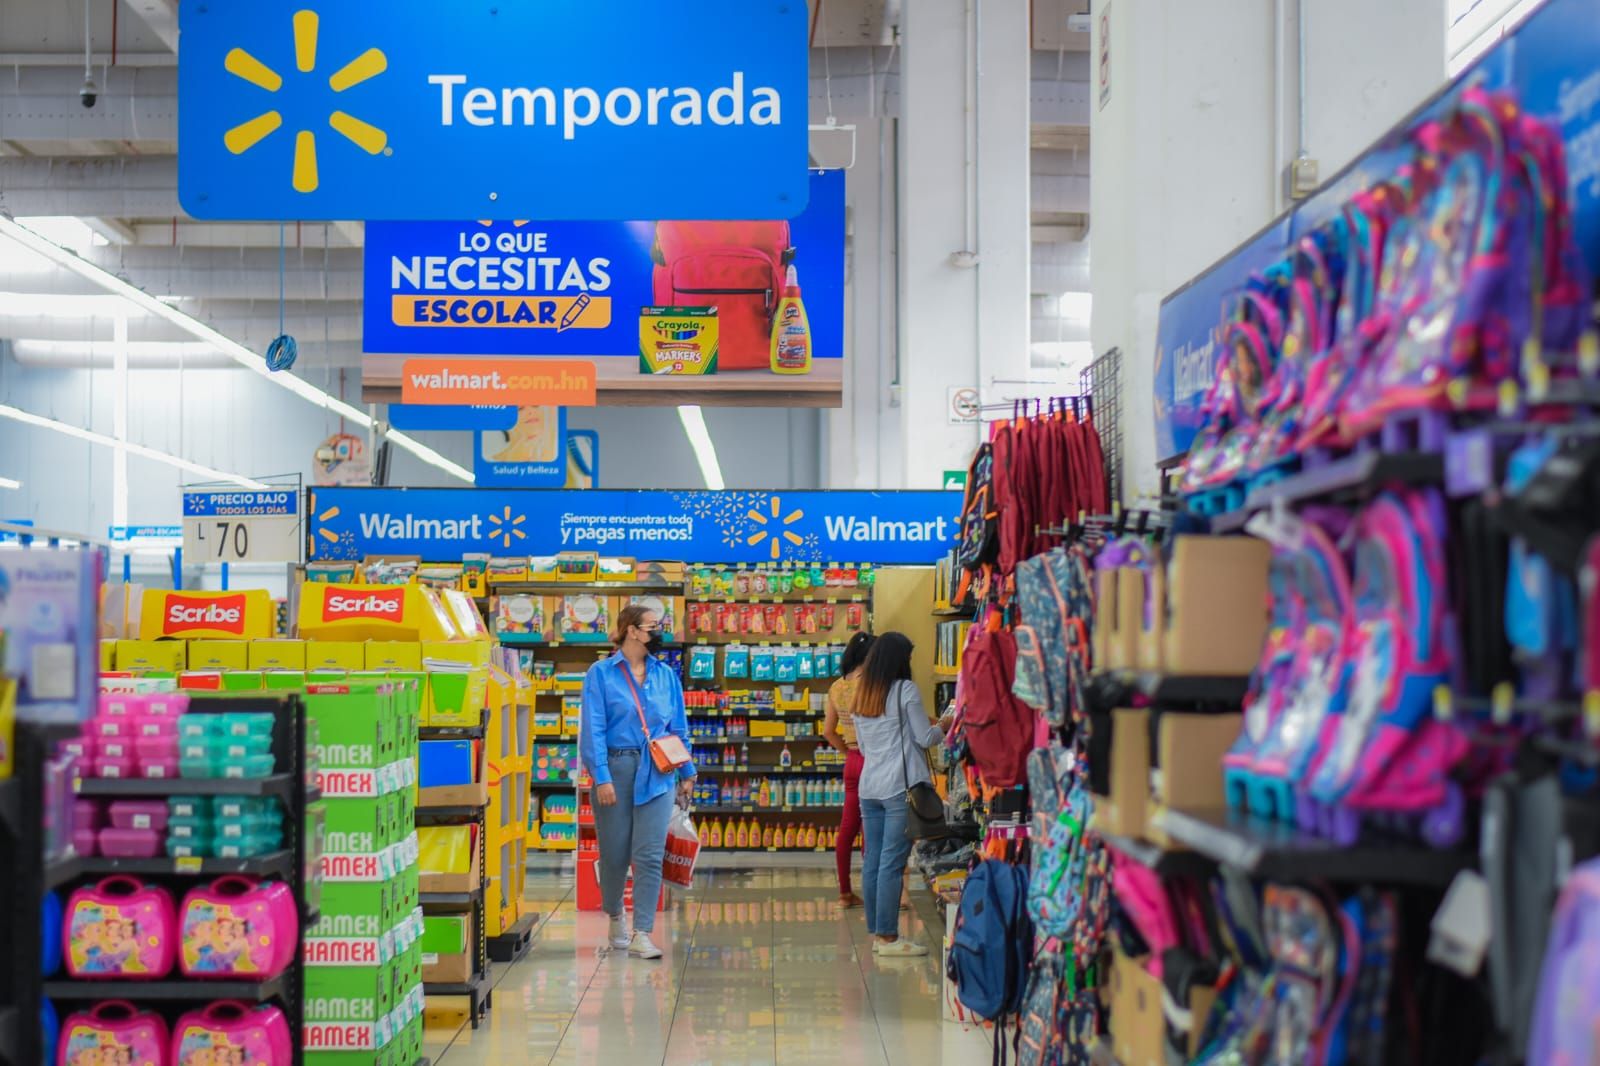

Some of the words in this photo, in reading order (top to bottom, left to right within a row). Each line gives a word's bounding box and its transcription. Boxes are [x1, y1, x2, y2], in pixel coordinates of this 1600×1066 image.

[427, 71, 782, 140] Temporada
[459, 232, 491, 252] LO
[495, 232, 548, 253] QUE
[391, 255, 611, 291] NECESITAS
[413, 299, 557, 324] ESCOLAR
[656, 320, 700, 331] Crayola
[655, 350, 702, 363] MARKERS
[411, 368, 588, 390] walmart.com.hn
[493, 465, 519, 474] Salud
[520, 468, 526, 476] y
[527, 465, 559, 474] Belleza
[210, 494, 254, 505] PRECIO
[257, 493, 288, 504] BAJO
[267, 505, 287, 514] DÍAS
[359, 512, 482, 539] Walmart
[560, 512, 607, 526] ¡Siempre
[608, 515, 666, 525] encuentras
[668, 514, 693, 525] todo
[824, 516, 947, 542] Walmart
[216, 522, 248, 558] 70
[560, 527, 572, 544] y
[574, 527, 625, 545] pagas
[629, 521, 693, 541] menos!
[169, 604, 240, 623] Scribe
[327, 596, 399, 613] Scribe
